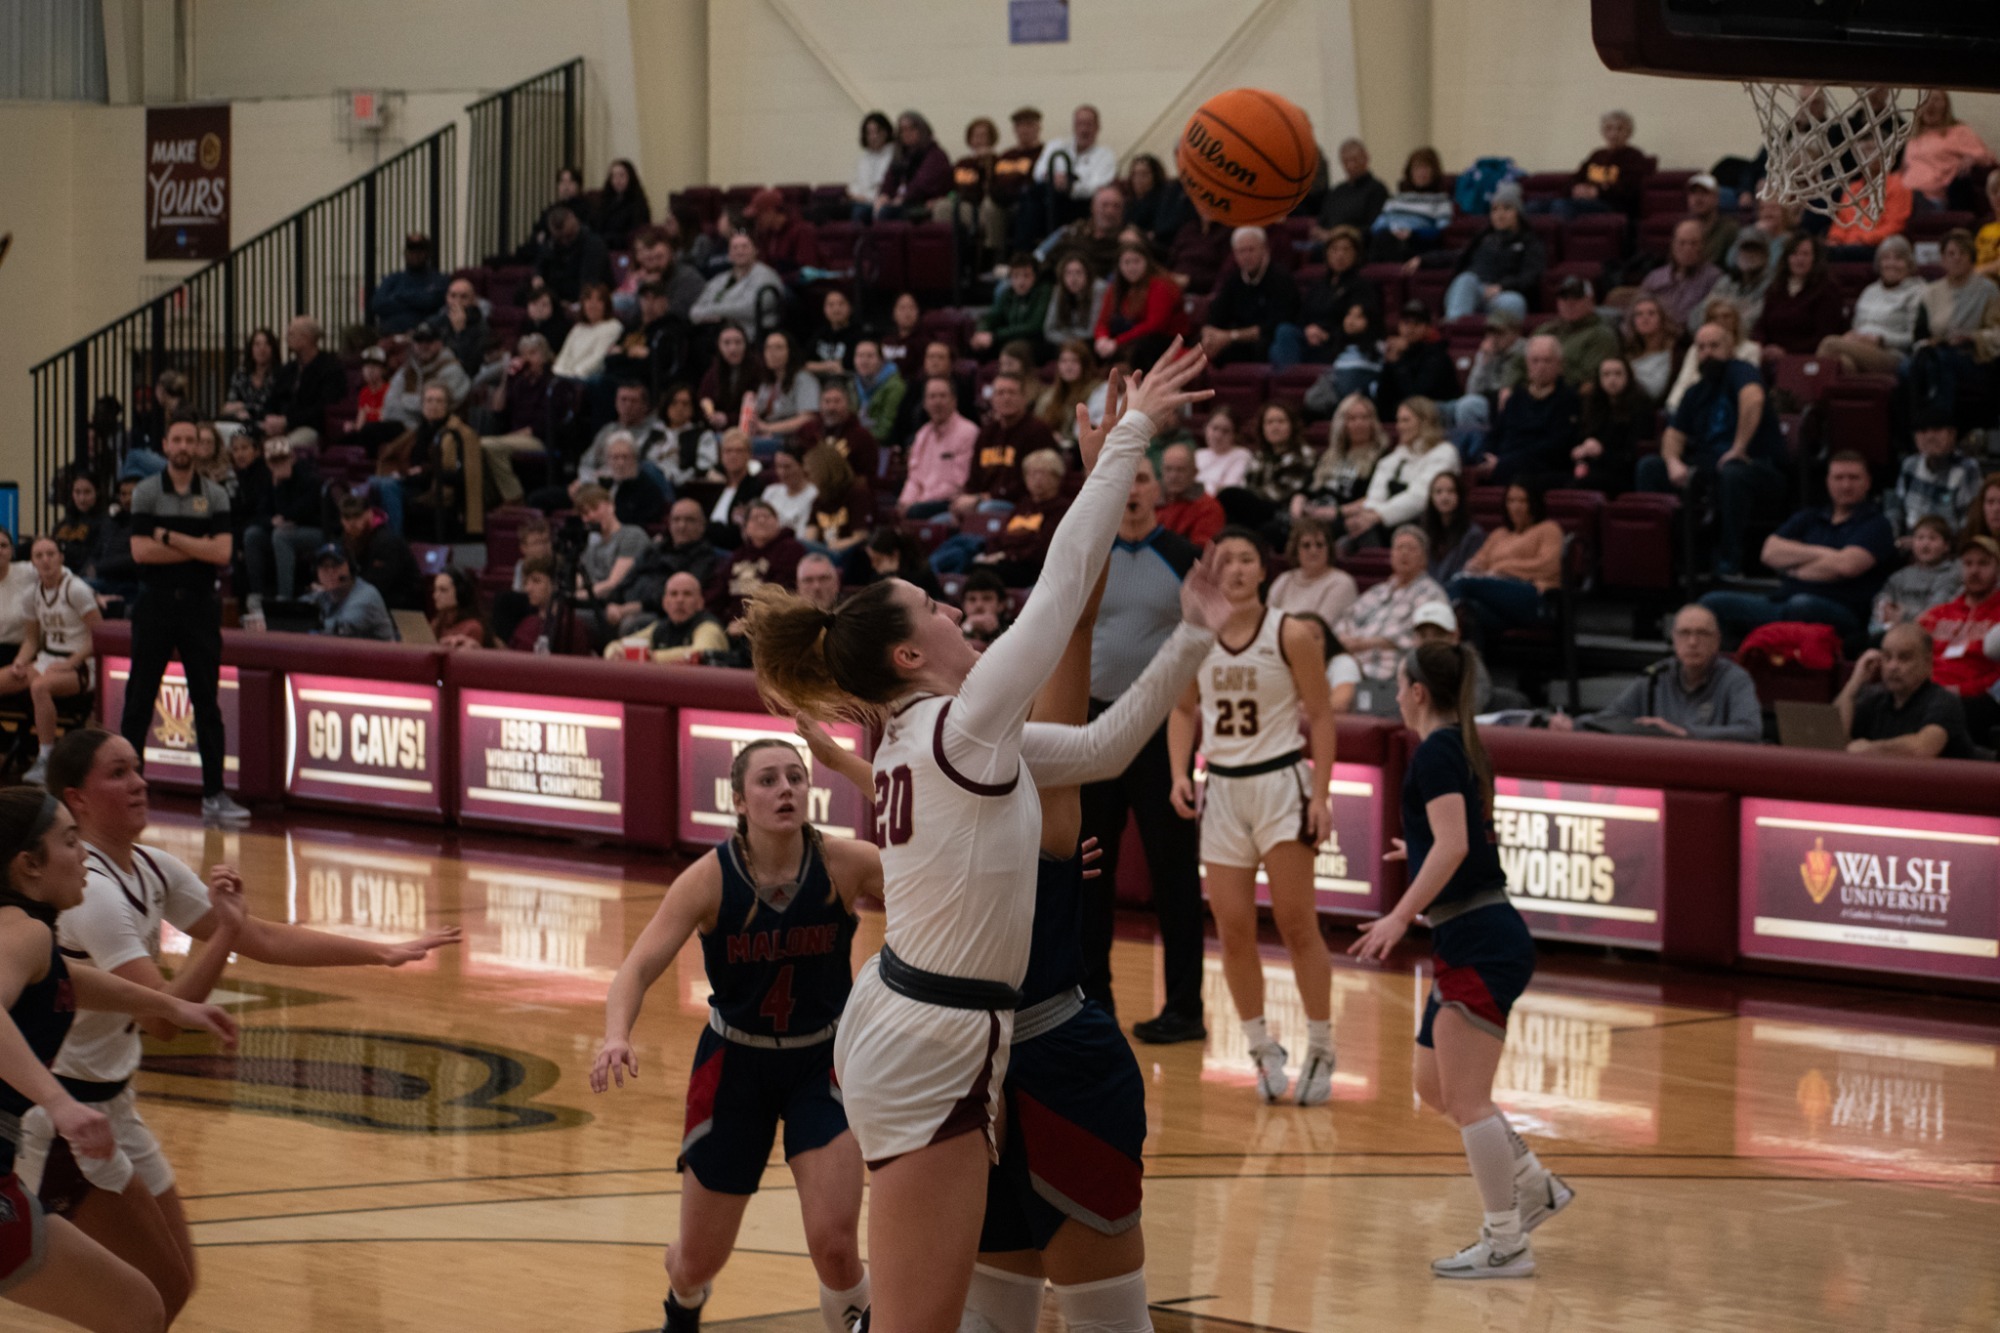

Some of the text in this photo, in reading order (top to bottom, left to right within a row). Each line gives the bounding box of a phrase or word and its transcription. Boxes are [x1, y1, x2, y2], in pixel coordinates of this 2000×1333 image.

[151, 139, 197, 164] MAKE
[1187, 121, 1258, 187] Wilson
[149, 163, 226, 229] YOURS
[1212, 665, 1257, 691] CAVS
[501, 718, 588, 757] 1998 NAIA
[1215, 698, 1259, 737] 23
[307, 709, 426, 771] GO CAVS!
[486, 767, 602, 799] NATIONAL CHAMPIONS
[536, 753, 604, 779] BASKETBALL
[875, 763, 913, 849] 20
[1493, 809, 1606, 854] FEAR THE
[1498, 846, 1615, 903] WORDS
[1834, 851, 1951, 895] WALSH
[1840, 886, 1950, 913] UNIVERSITY
[727, 923, 839, 964] MALONE
[760, 964, 796, 1032] 4
